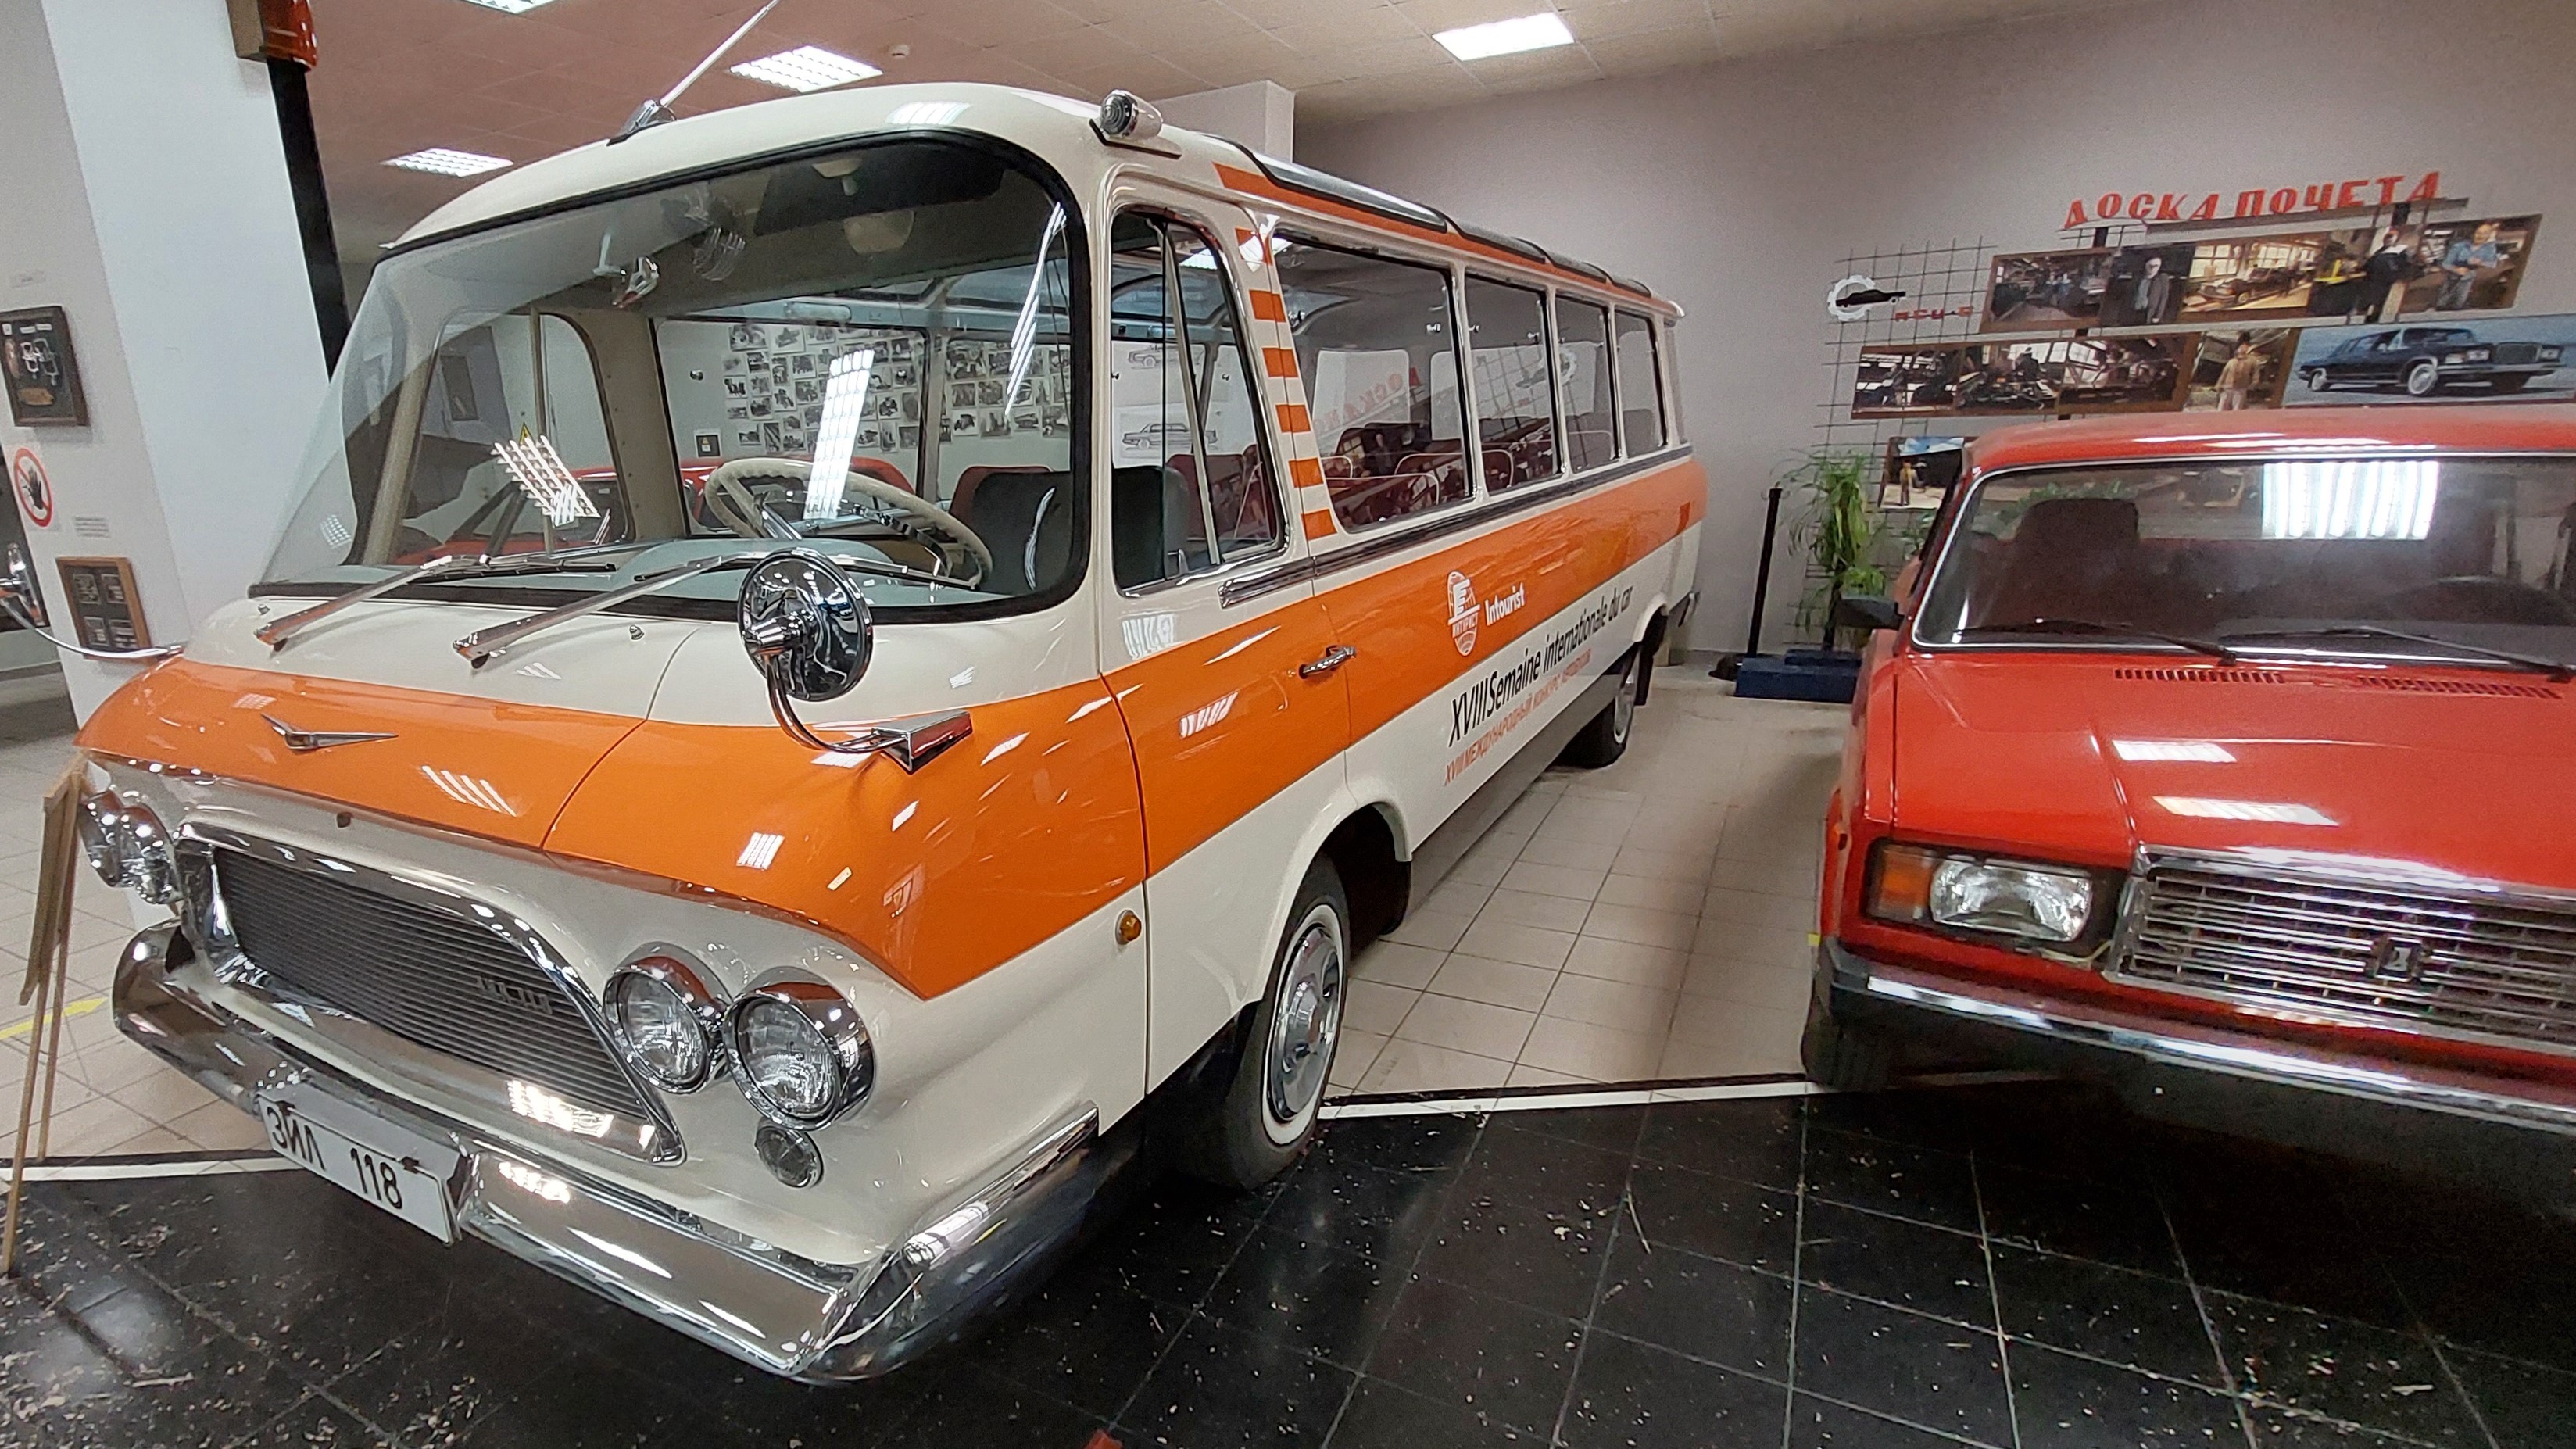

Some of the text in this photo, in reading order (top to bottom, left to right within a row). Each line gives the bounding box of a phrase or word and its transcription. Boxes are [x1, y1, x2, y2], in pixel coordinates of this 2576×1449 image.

[2063, 171, 2440, 229] ДОСКА ПОЧЕТА
[1484, 581, 1526, 626] Intourist
[1448, 677, 1488, 747] XVIII
[1487, 647, 1540, 717] Semaine
[1543, 595, 1608, 674] internationale
[1608, 587, 1620, 621] du
[267, 1107, 402, 1209] ЗИЛ 118
